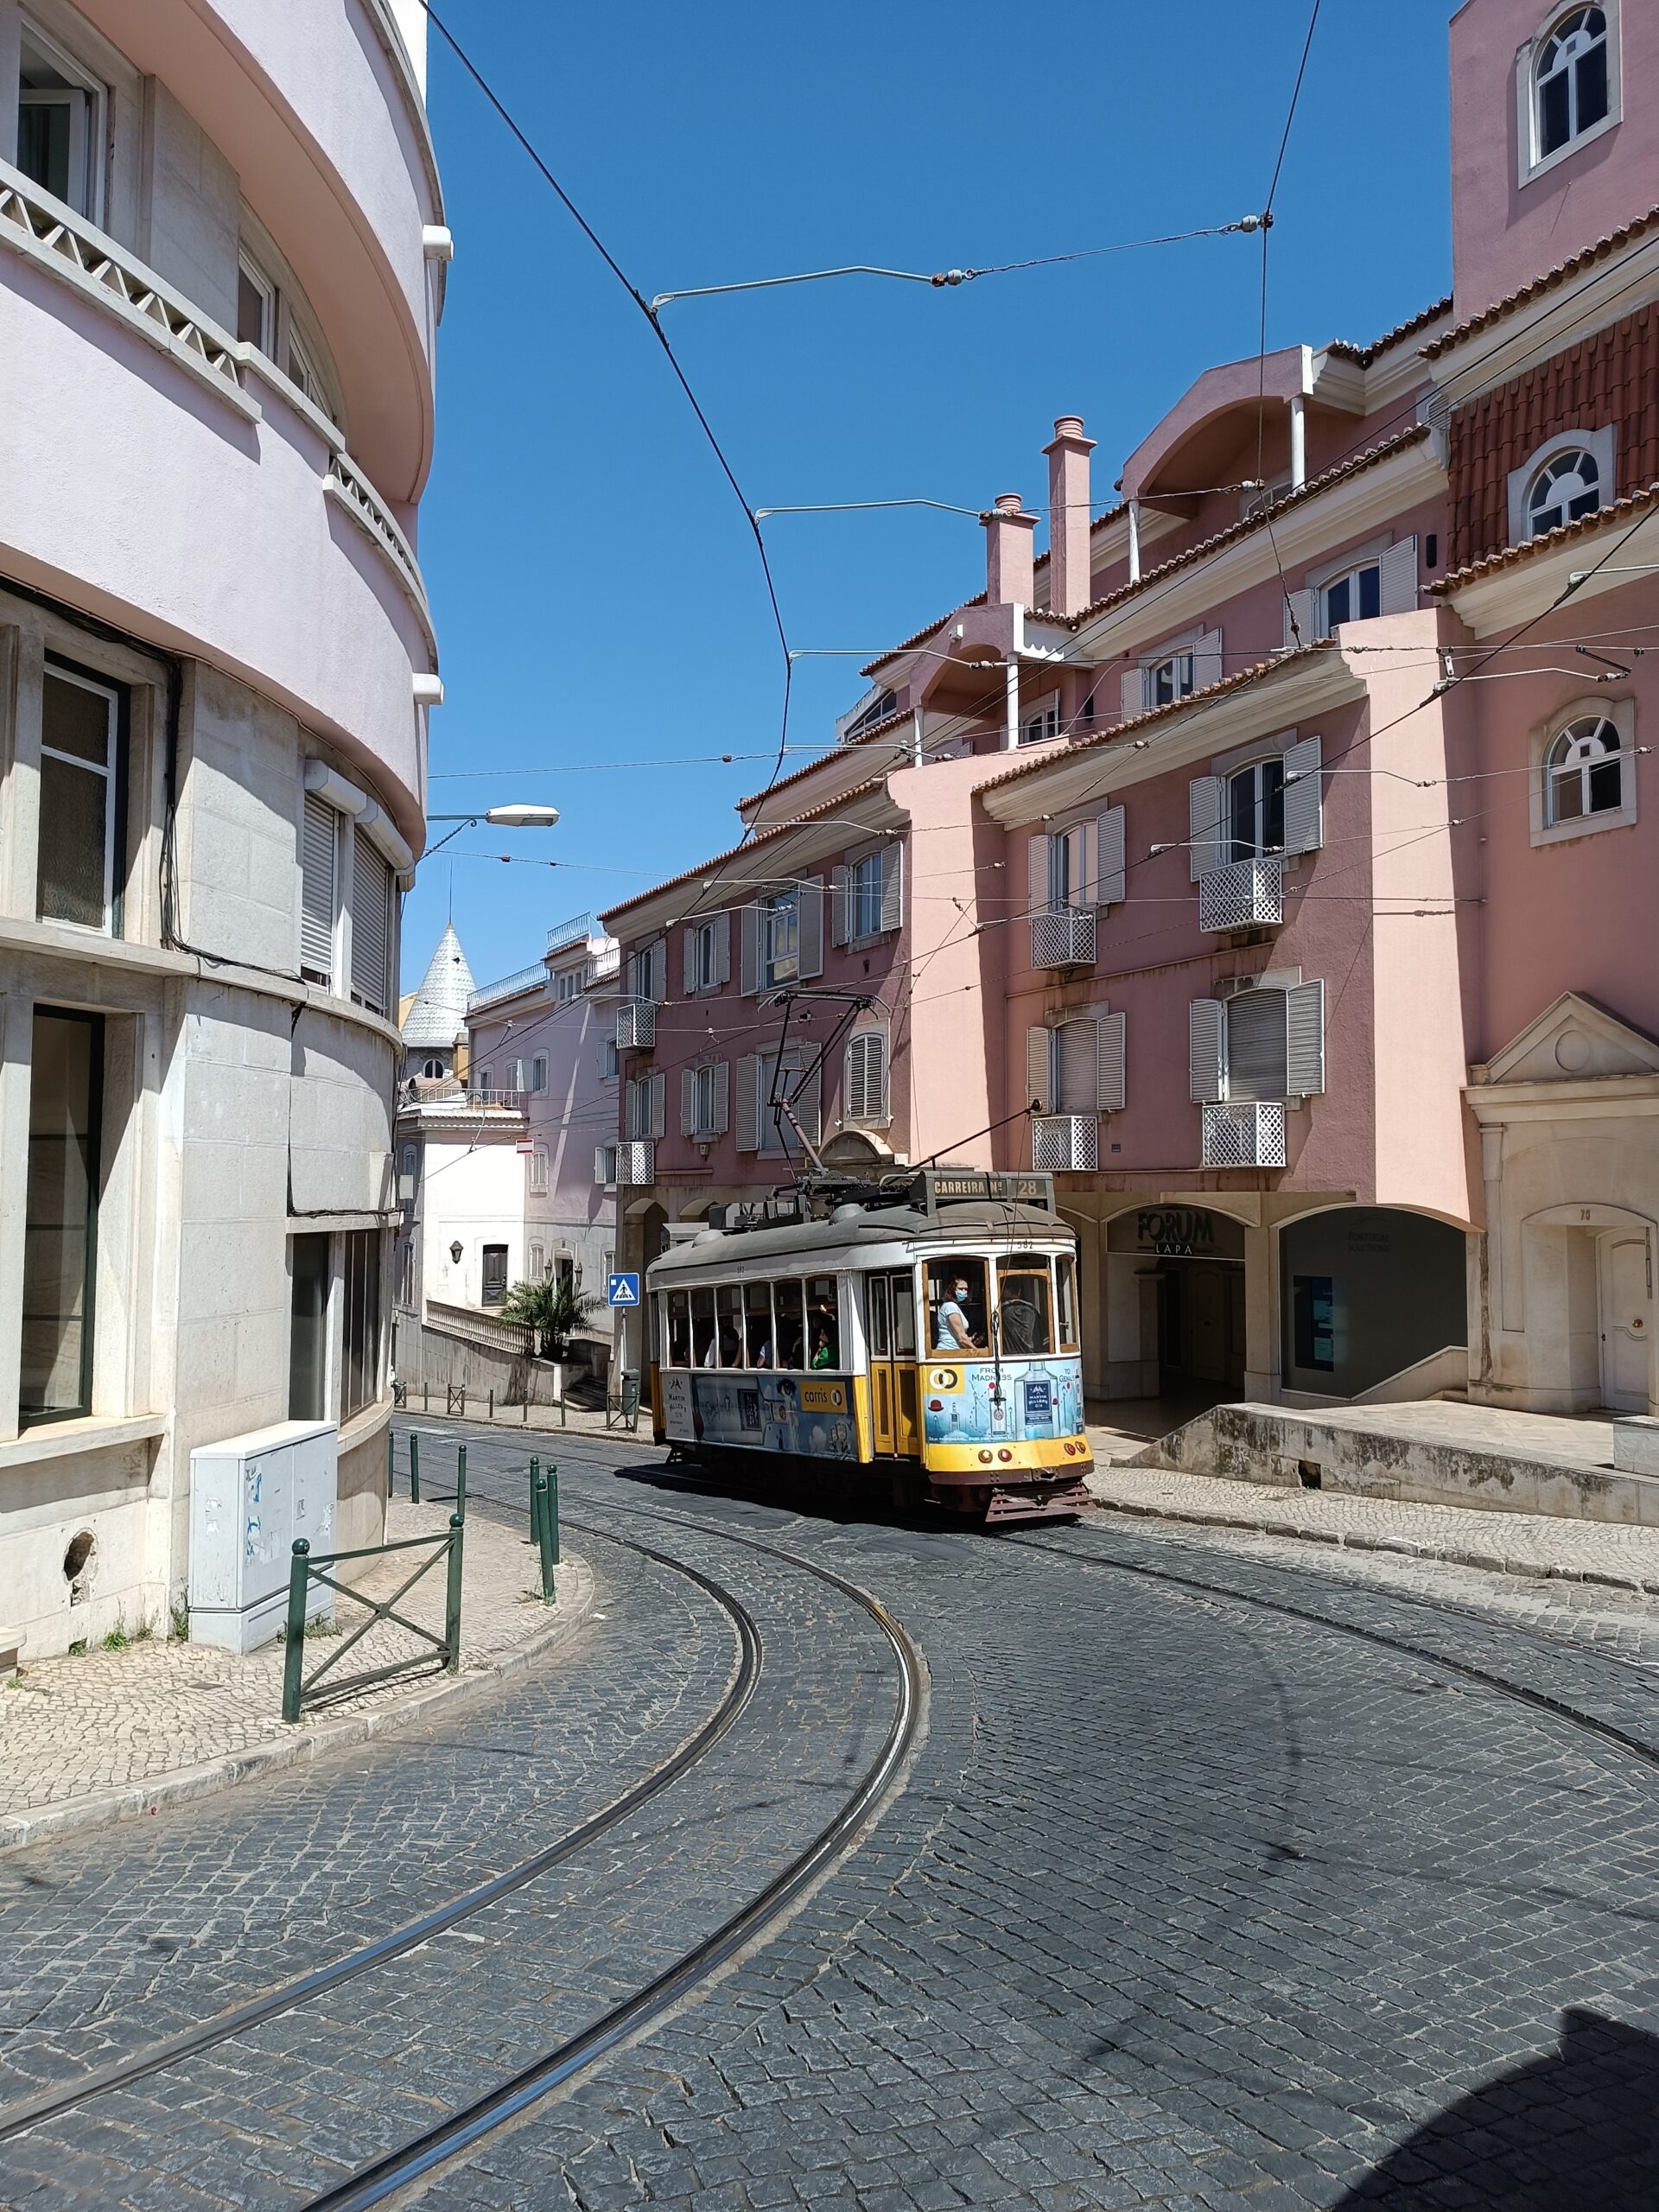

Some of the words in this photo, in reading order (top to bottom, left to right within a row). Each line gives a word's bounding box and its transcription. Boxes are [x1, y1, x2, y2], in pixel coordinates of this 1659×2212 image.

[934, 1181, 984, 1193] CARREIRA
[1019, 1181, 1038, 1195] 28
[1137, 1211, 1214, 1243] FORUM
[1017, 1241, 1033, 1249] 582
[1156, 1244, 1192, 1255] LAPA
[804, 1387, 828, 1403] carris
